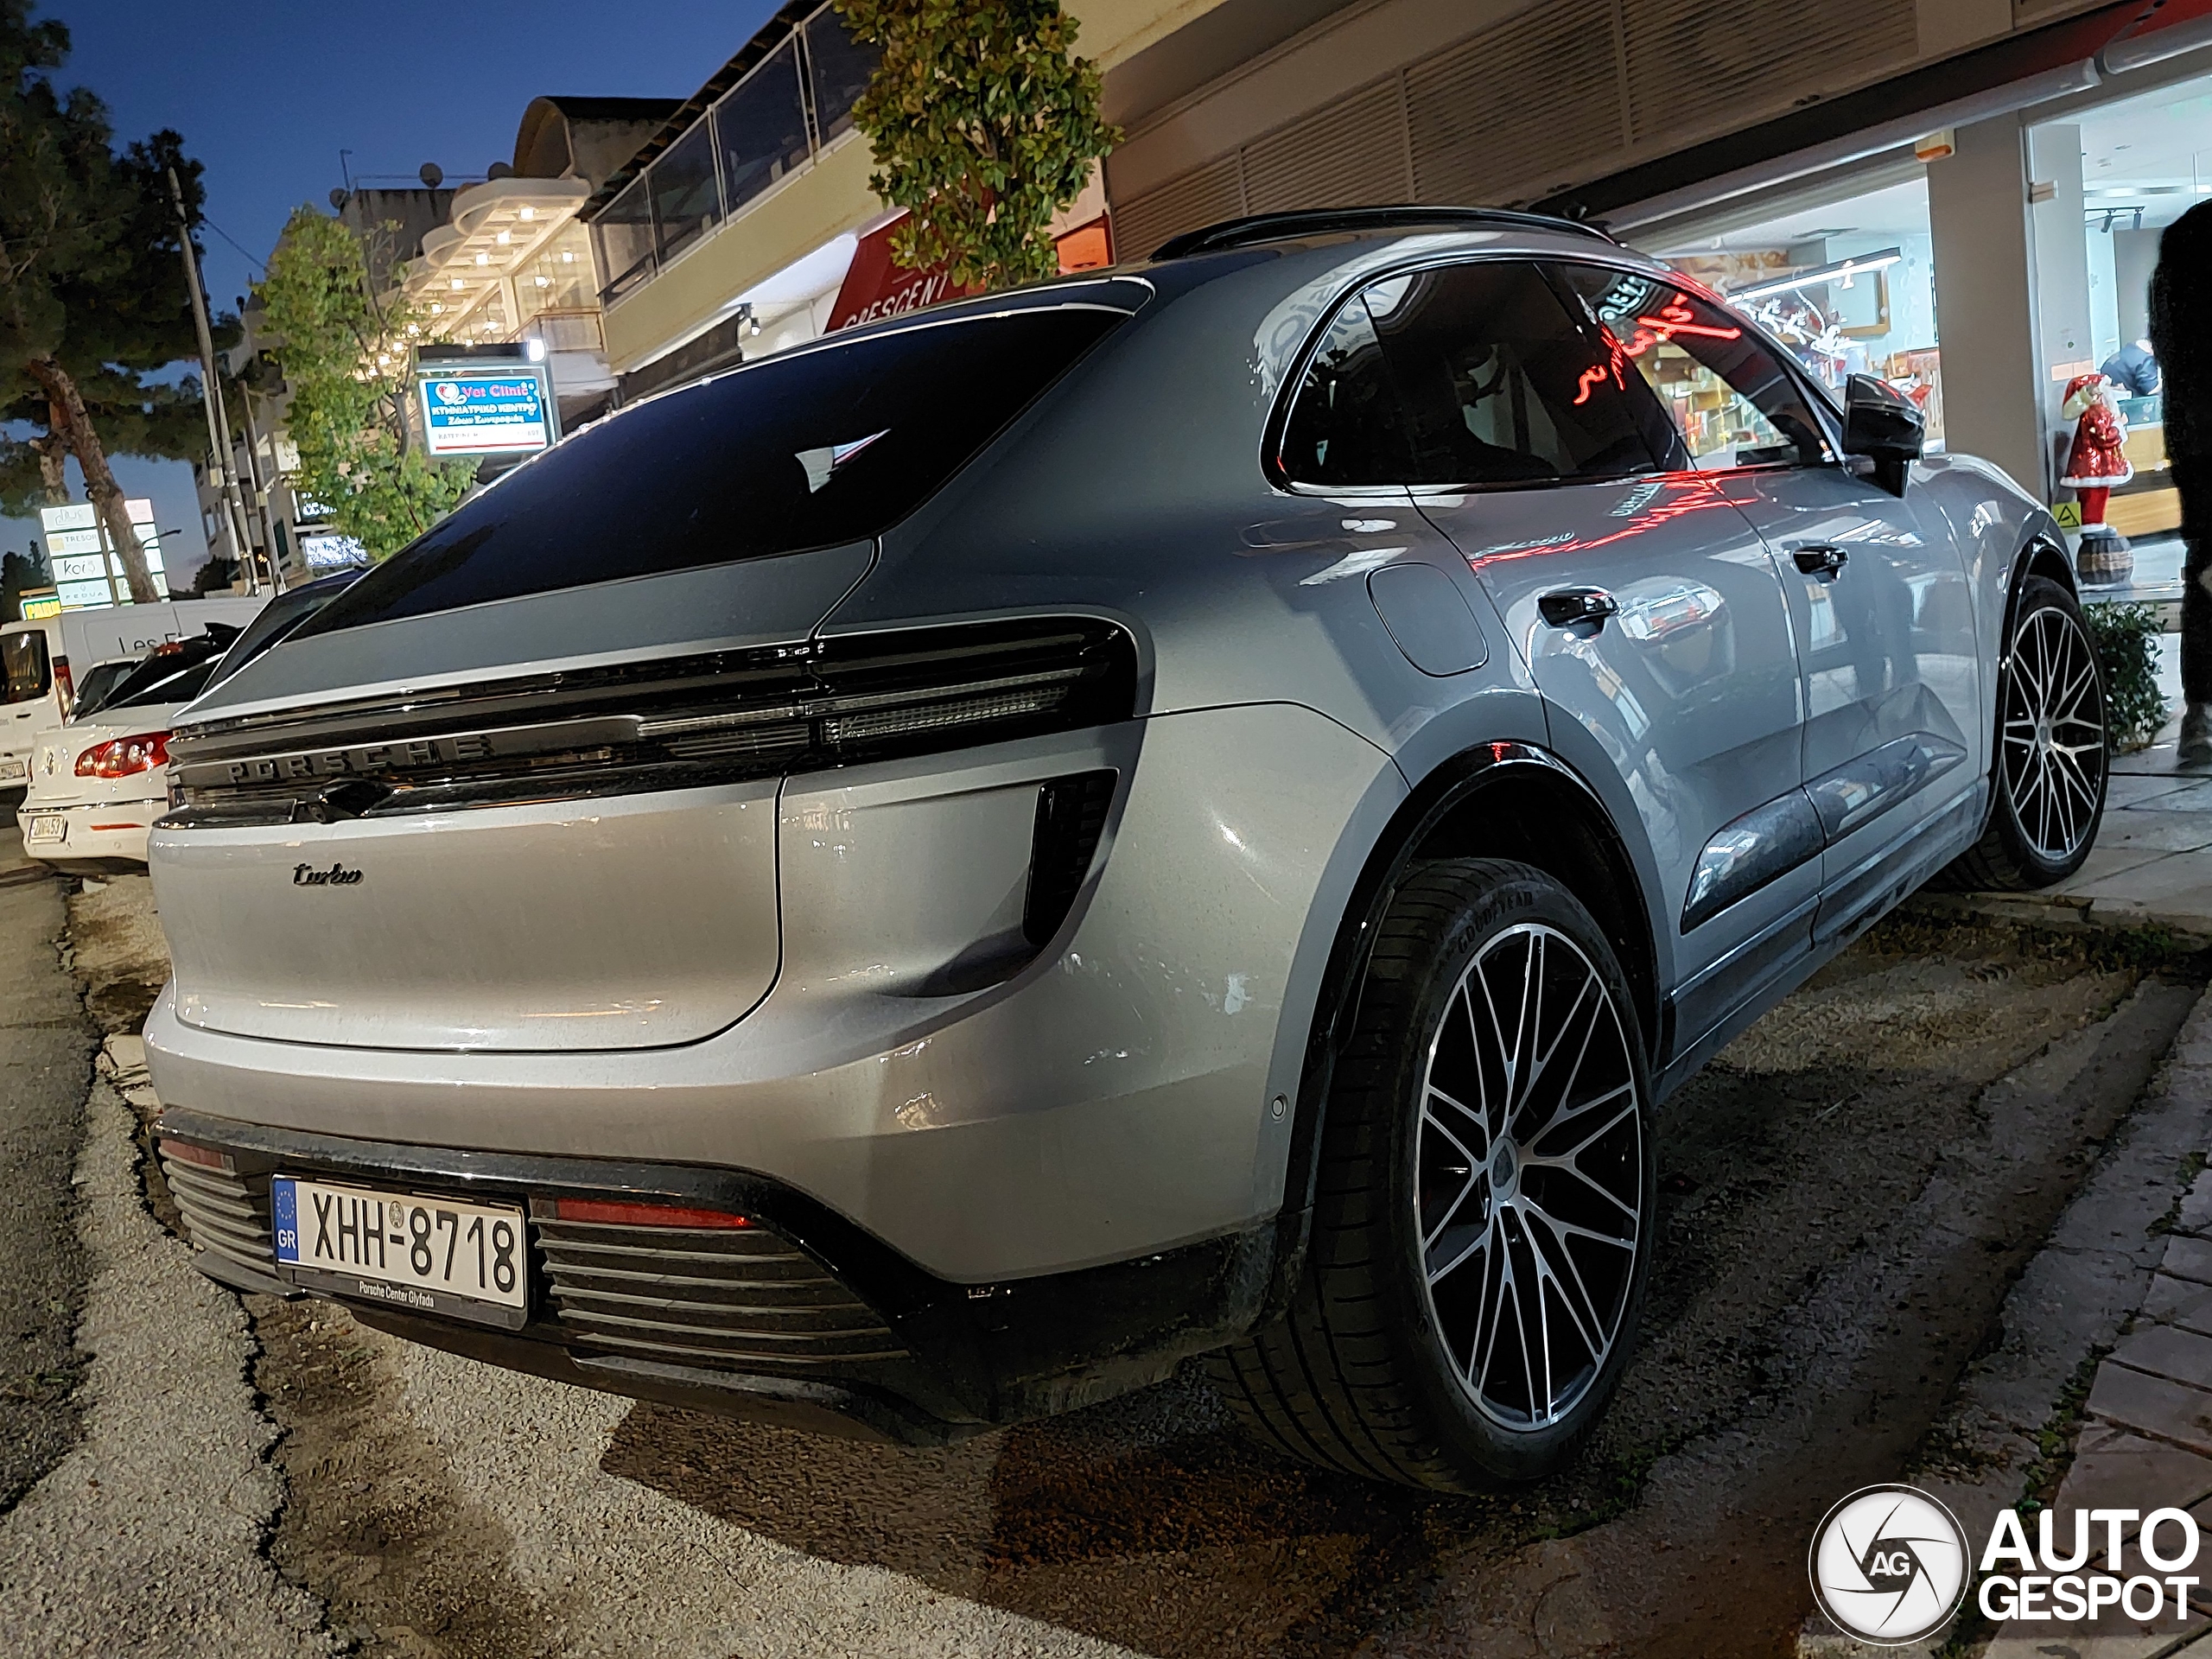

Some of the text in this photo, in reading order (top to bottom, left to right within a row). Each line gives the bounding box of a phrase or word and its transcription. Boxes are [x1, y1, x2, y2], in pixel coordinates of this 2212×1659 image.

[461, 384, 529, 397] Vet Clinic
[65, 534, 98, 543] TRESOR
[227, 735, 486, 784] PORSCHE
[292, 862, 363, 886] turbo
[277, 1229, 296, 1250] GR
[312, 1192, 516, 1294] XHH-8718
[359, 1281, 435, 1307] Porsche Center Glyfada
